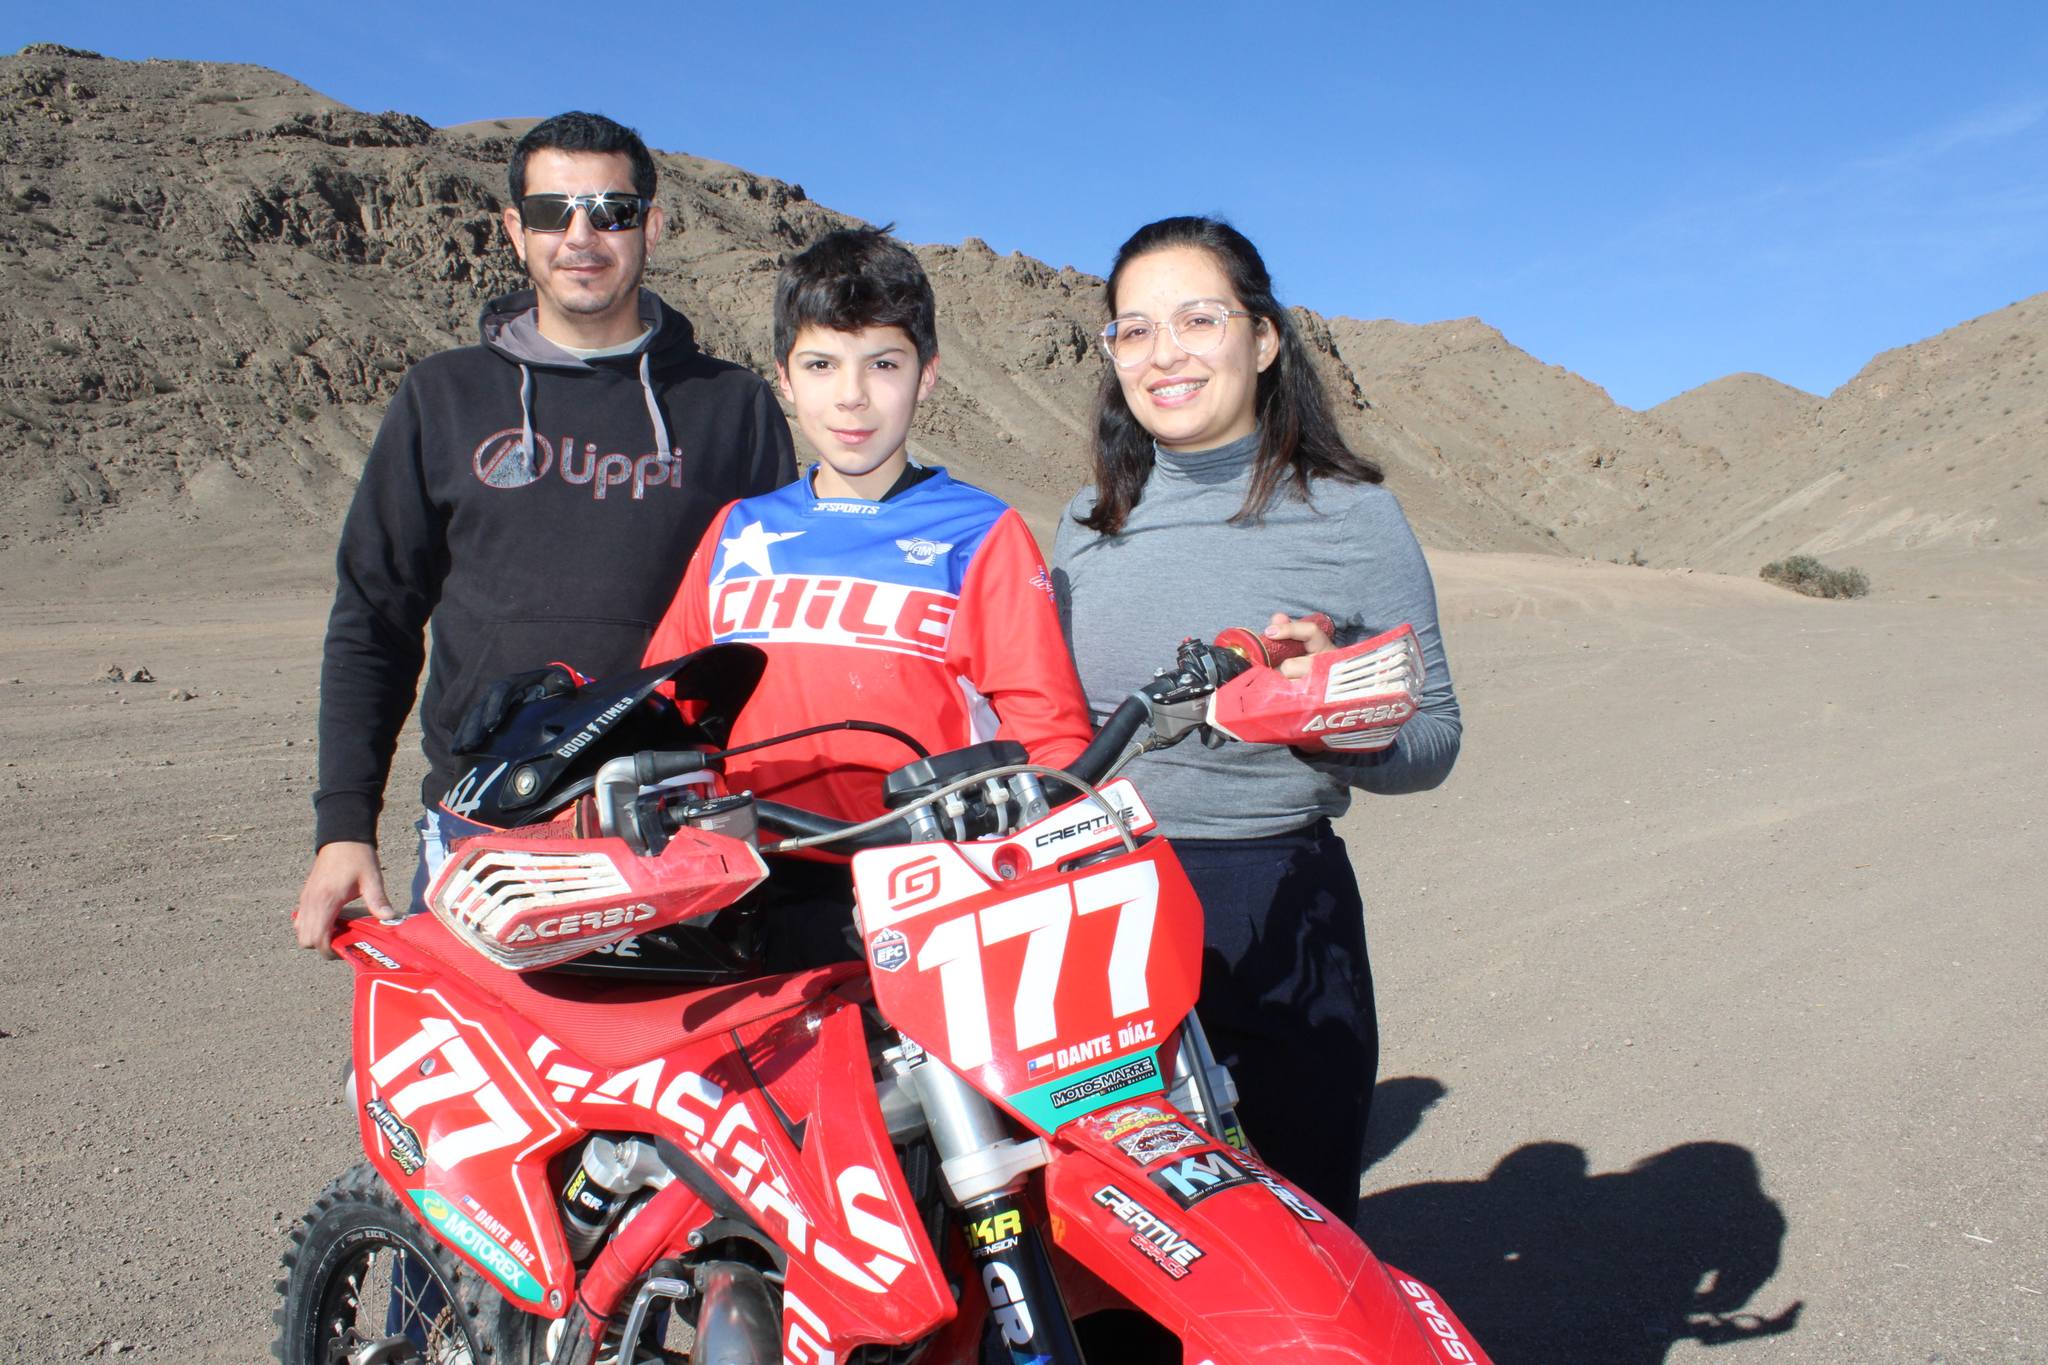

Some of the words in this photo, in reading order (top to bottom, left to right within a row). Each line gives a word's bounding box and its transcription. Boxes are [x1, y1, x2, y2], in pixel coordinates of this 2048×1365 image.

[556, 731, 593, 760] GOOD
[595, 696, 634, 726] TIMES
[1302, 702, 1413, 733] ACERBIS
[1035, 806, 1135, 848] CREATIE
[506, 903, 657, 945] ACERBIS
[354, 942, 400, 969] ENDURO
[917, 859, 1160, 1071] 177
[1057, 1034, 1112, 1070] DANTE
[1117, 1019, 1156, 1049] DÍAZ
[369, 1017, 533, 1172] 177
[1160, 1153, 1243, 1198] KM
[444, 1212, 525, 1289] MOTOREX
[474, 1209, 512, 1245] DANTE
[509, 1239, 536, 1267] DÍAZ
[1094, 1184, 1202, 1267] CREATIVE
[1400, 1280, 1477, 1365] SGAS
